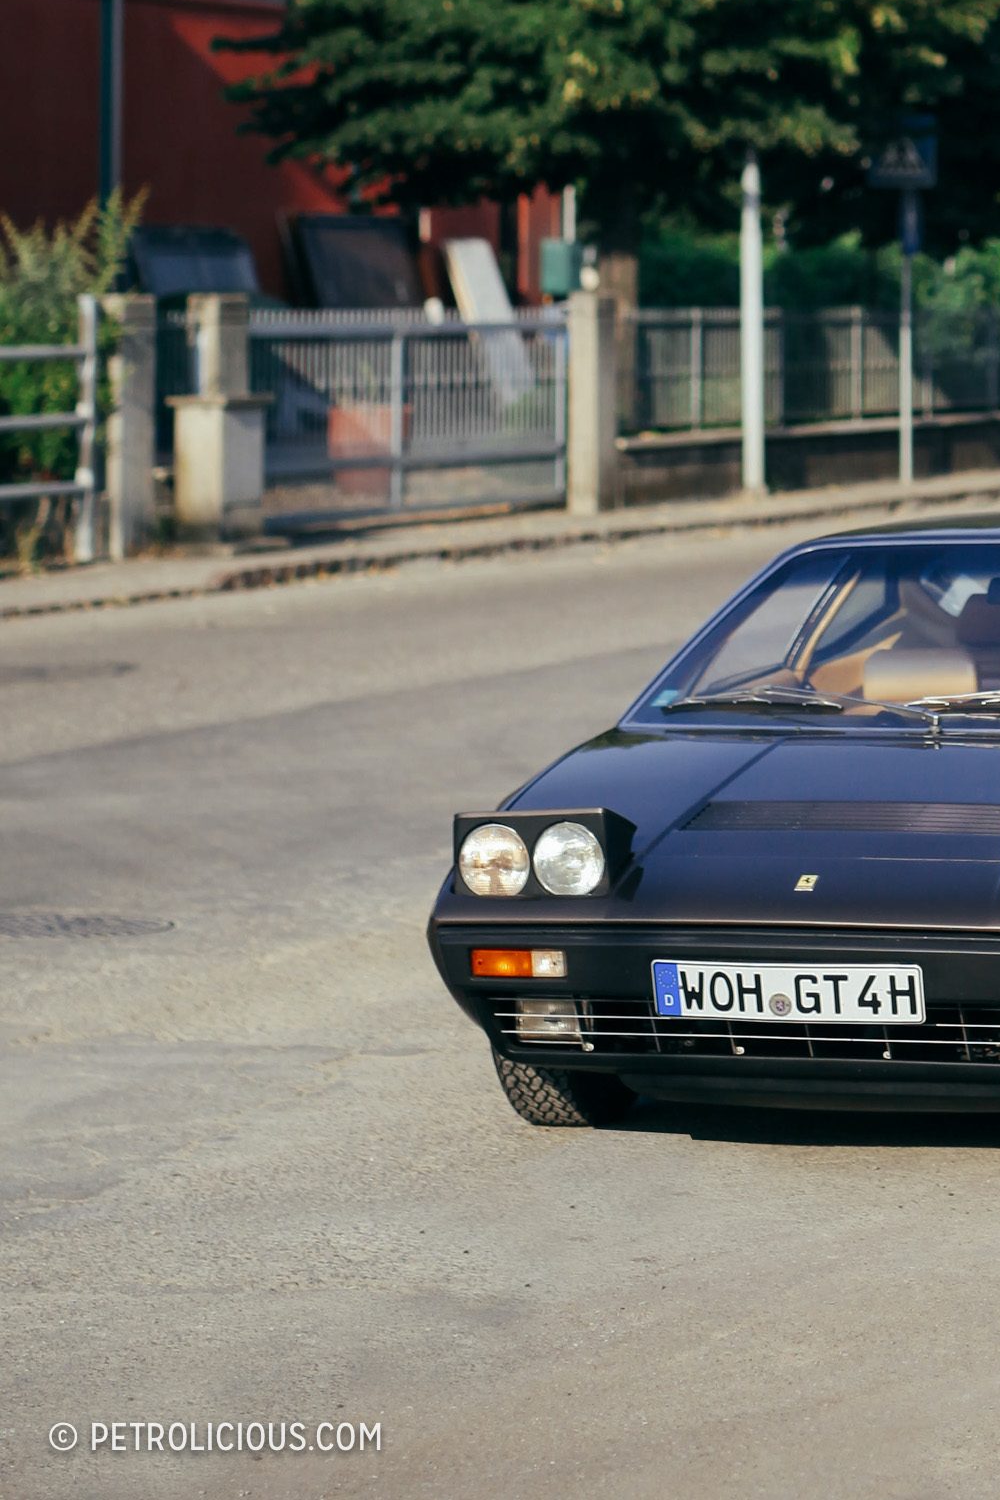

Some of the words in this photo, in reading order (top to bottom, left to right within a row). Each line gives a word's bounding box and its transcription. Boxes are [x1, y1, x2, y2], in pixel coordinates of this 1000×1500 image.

[664, 994, 675, 1007] D
[679, 970, 764, 1013] WOH
[794, 974, 849, 1015] GT
[857, 975, 918, 1016] 4H
